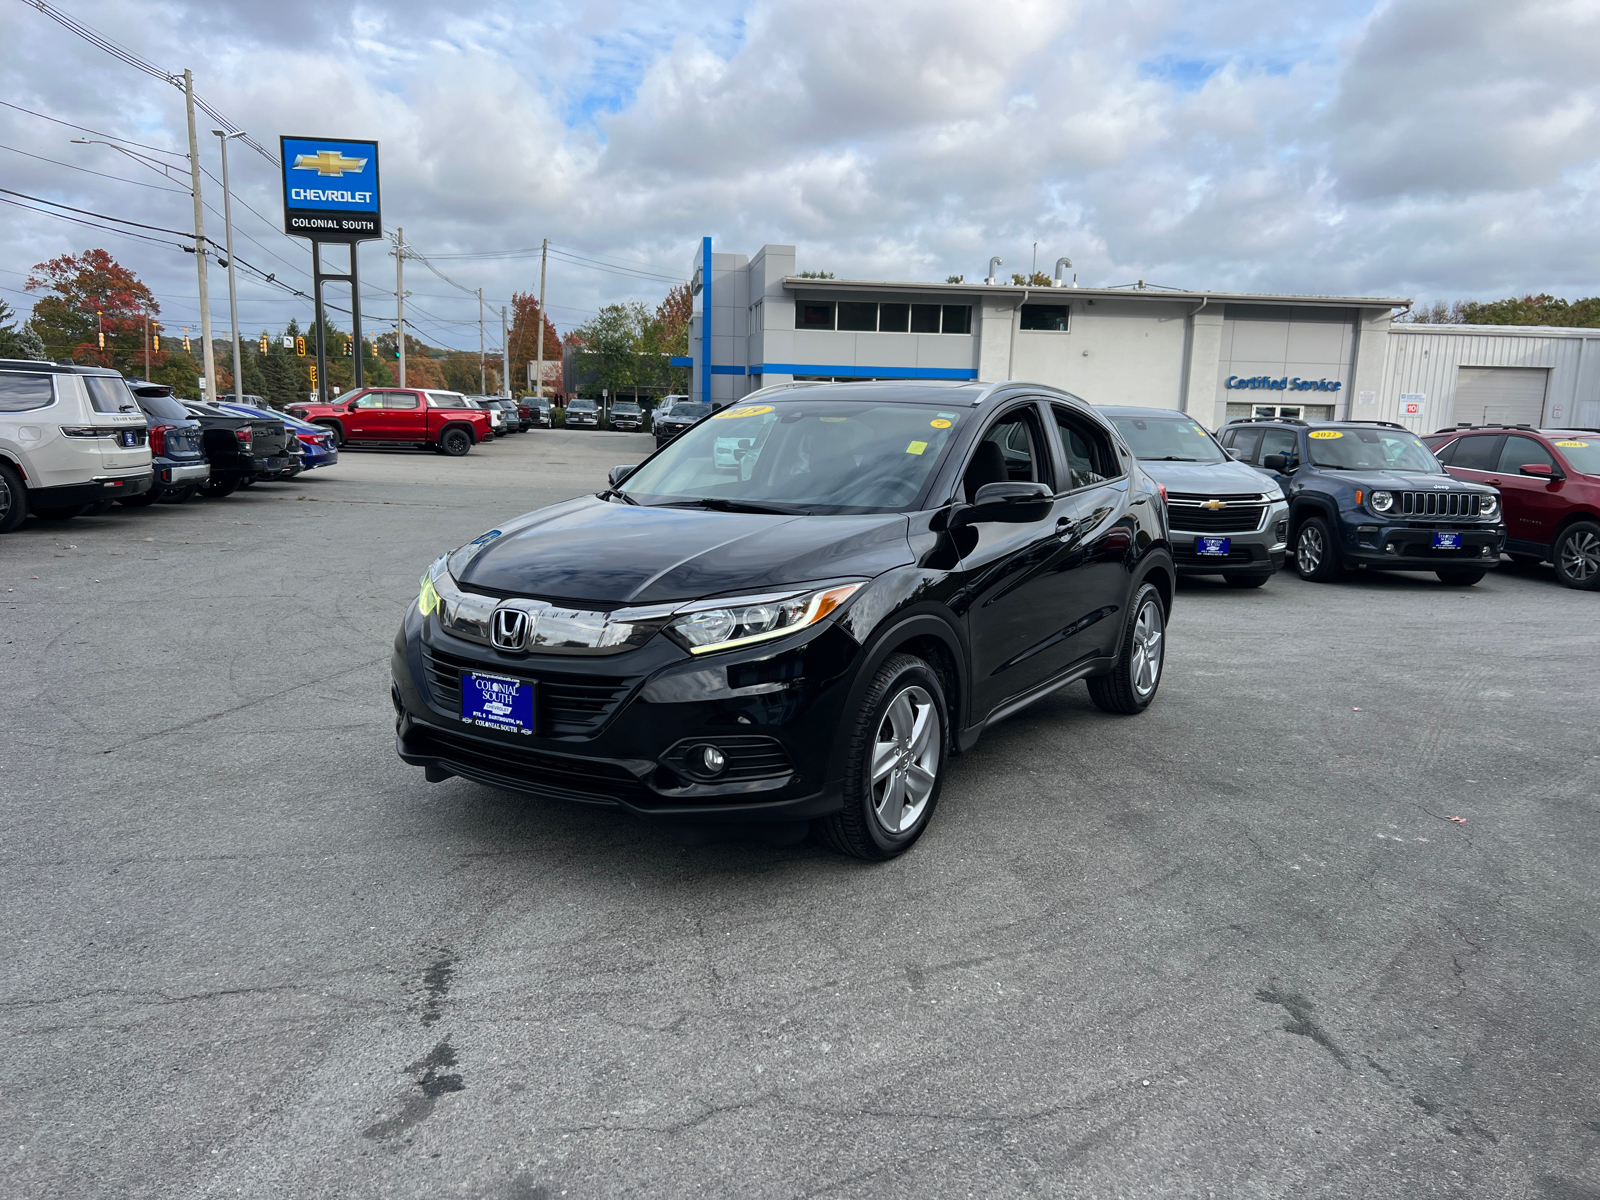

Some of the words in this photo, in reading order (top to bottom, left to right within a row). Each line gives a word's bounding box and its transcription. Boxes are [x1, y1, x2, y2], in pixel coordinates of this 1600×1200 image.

[291, 188, 372, 203] CHEVROLET
[292, 218, 339, 229] COLONIAL
[342, 220, 374, 230] SOUTH
[1227, 376, 1288, 390] Certified
[1292, 377, 1342, 391] Service
[475, 679, 520, 697] COLONIAL
[482, 690, 513, 705] SOUTH
[486, 703, 510, 713] CHEVROLET
[475, 719, 500, 730] COLONIAL
[500, 724, 518, 733] SOUTH
